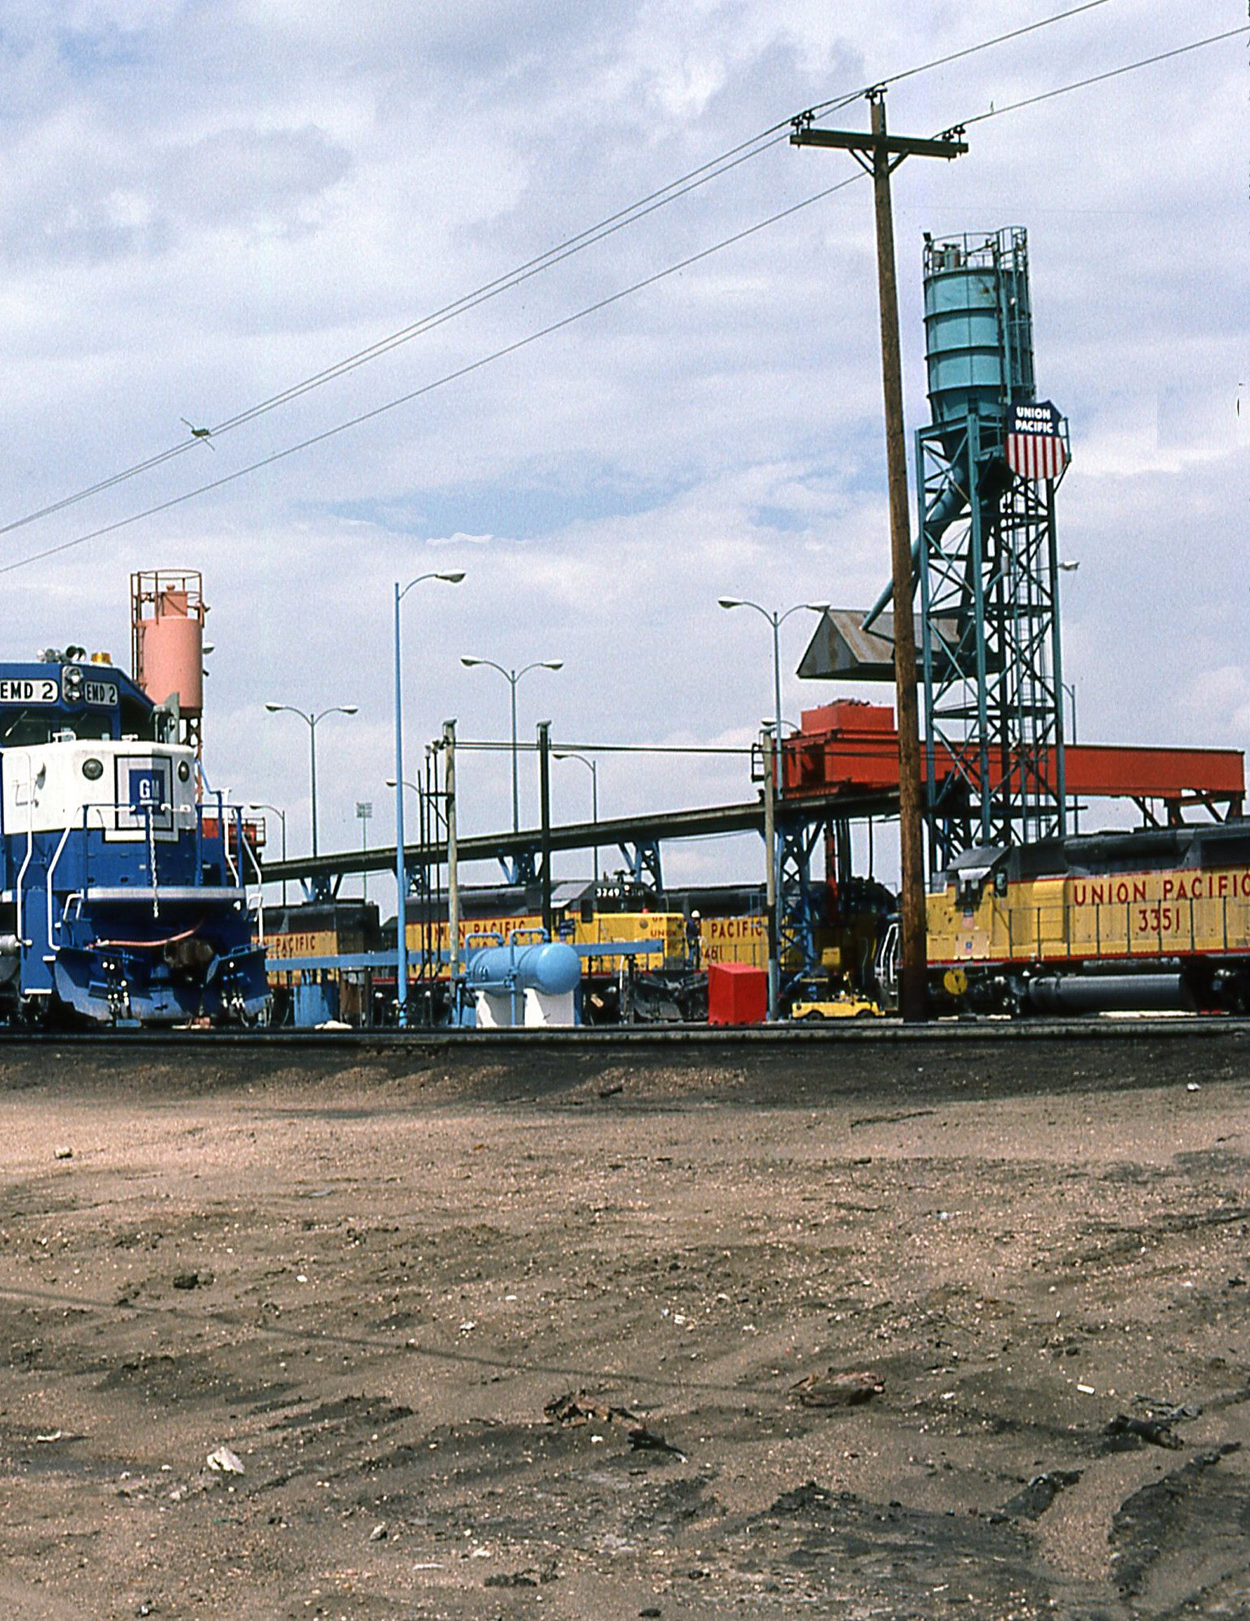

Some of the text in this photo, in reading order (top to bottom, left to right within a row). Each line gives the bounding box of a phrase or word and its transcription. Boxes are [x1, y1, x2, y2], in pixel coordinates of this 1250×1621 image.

[1016, 406, 1051, 420] UNION
[1015, 420, 1053, 433] PACIFIC
[0, 682, 54, 699] EMD 2
[86, 682, 116, 703] EMD 2
[139, 779, 160, 798] GM
[1074, 873, 1250, 906] UNION PACIFIC
[473, 920, 525, 939] PACIFIC
[711, 920, 763, 939] PACIFIC
[1138, 908, 1180, 932] 3351
[276, 935, 316, 953] PACIFIC
[700, 945, 723, 961] 461
